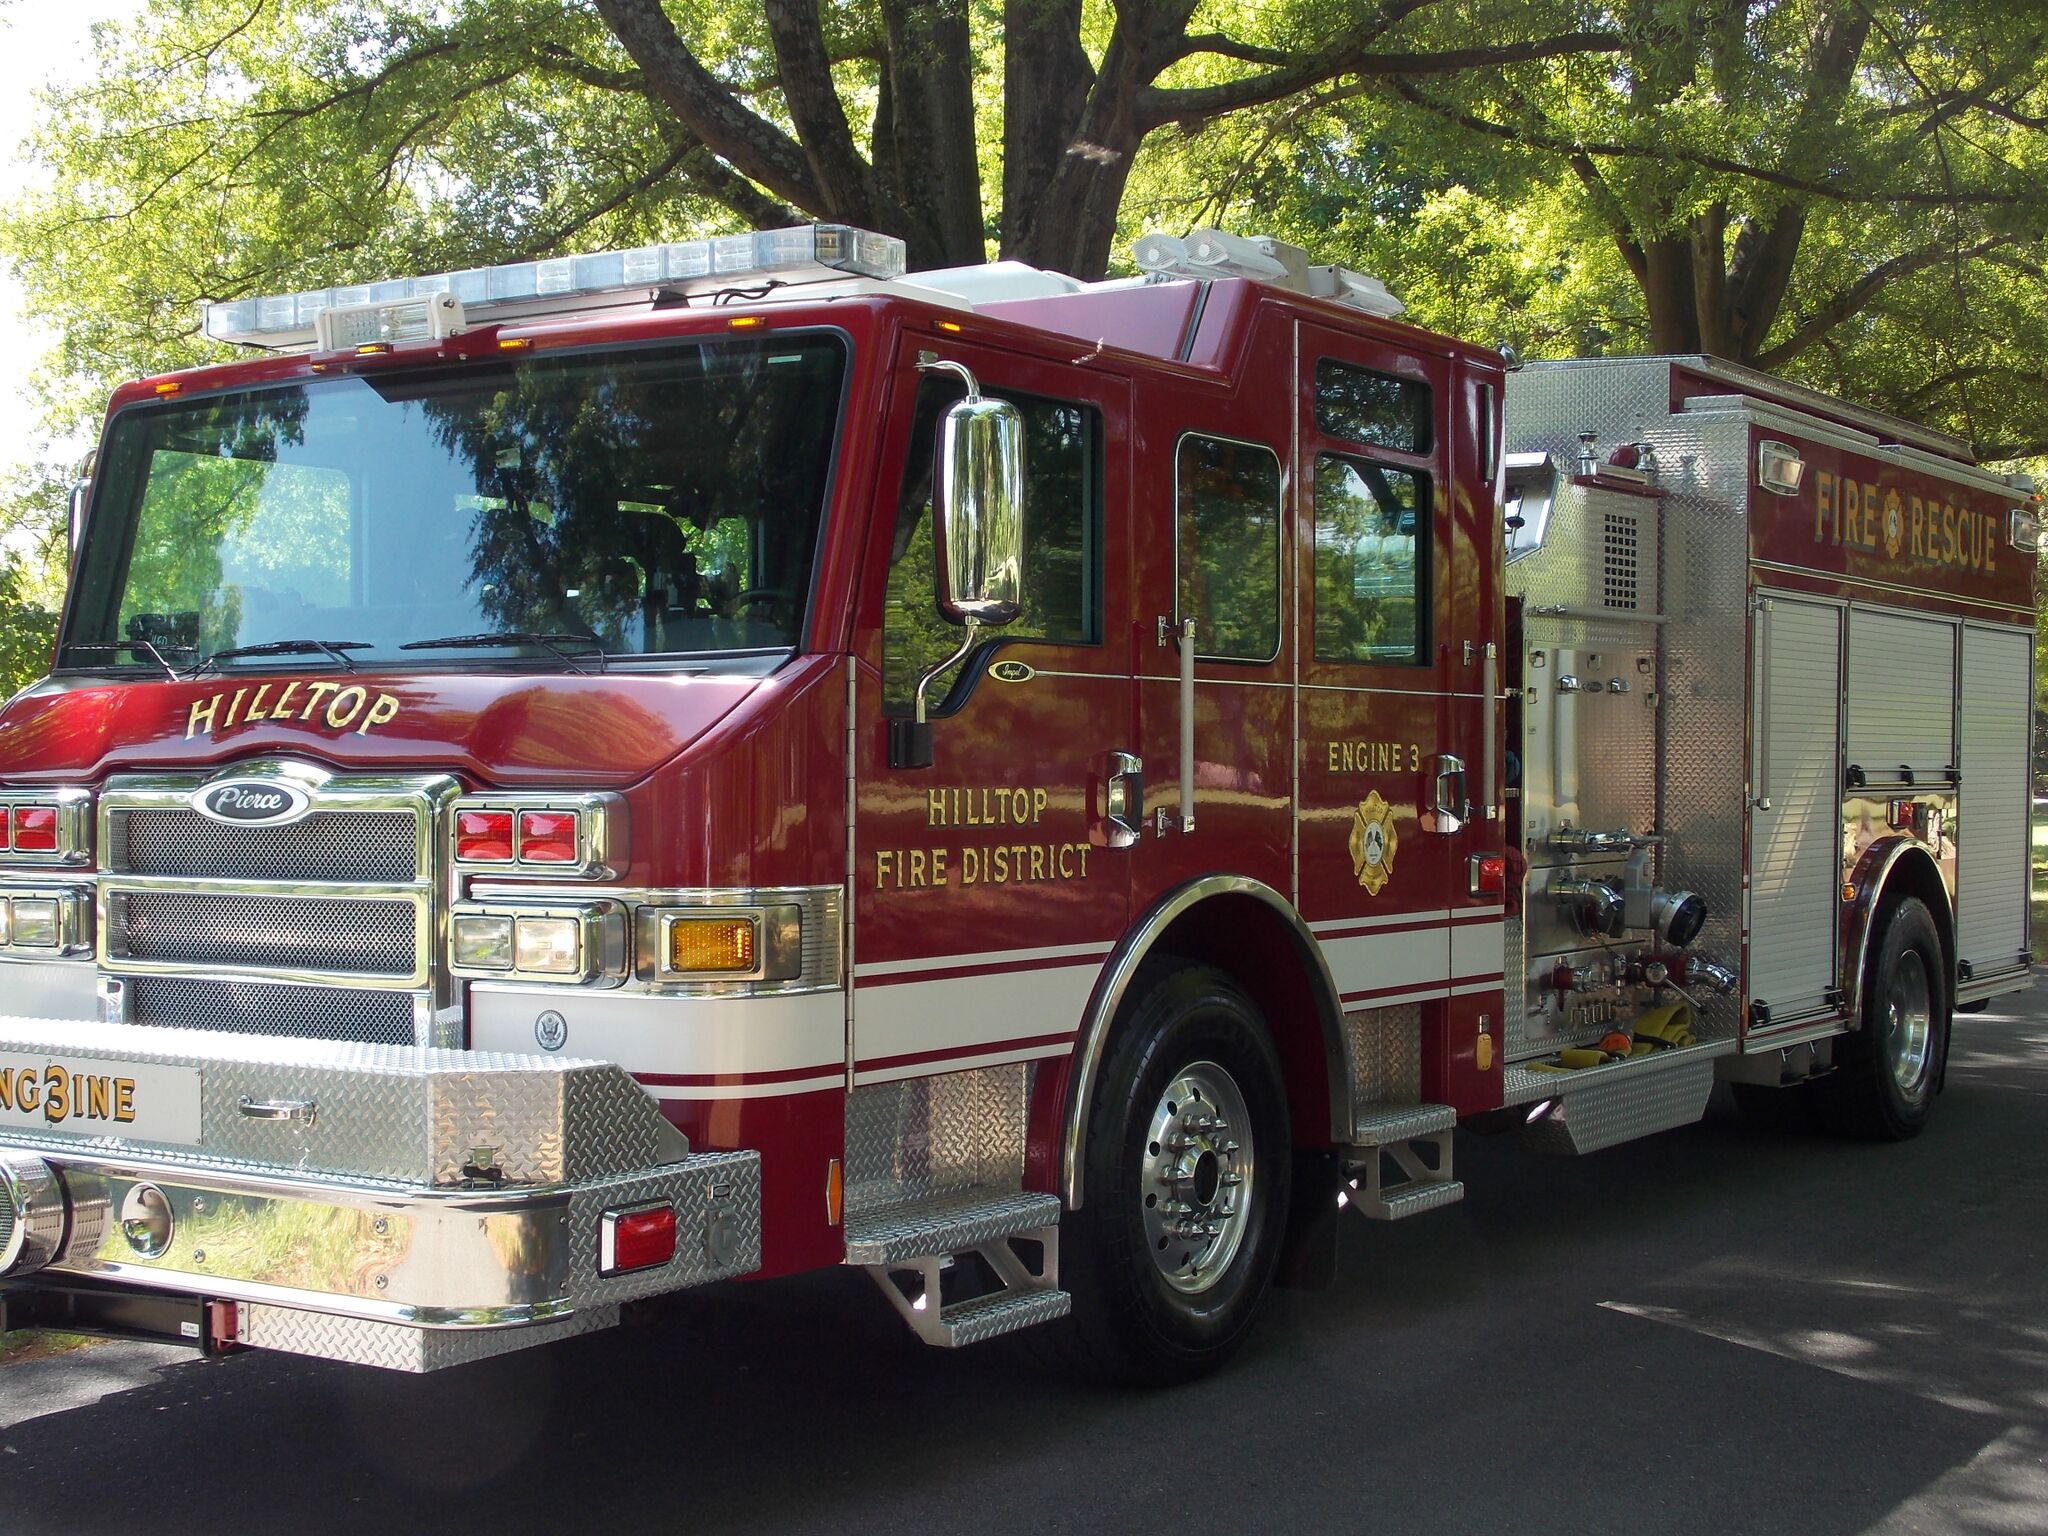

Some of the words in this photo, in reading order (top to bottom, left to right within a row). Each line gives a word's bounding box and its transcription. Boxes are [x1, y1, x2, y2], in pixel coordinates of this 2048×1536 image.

[1815, 471, 1877, 549] FIRE
[1911, 496, 1997, 573] RESCUE
[185, 681, 400, 740] HILLTOP
[1328, 741, 1402, 772] ENGINE
[1410, 743, 1420, 772] 3
[215, 787, 283, 812] Pierce
[928, 787, 1048, 826] HILLTOP
[876, 848, 948, 889] FIRE
[962, 842, 1092, 884] DISTRICT
